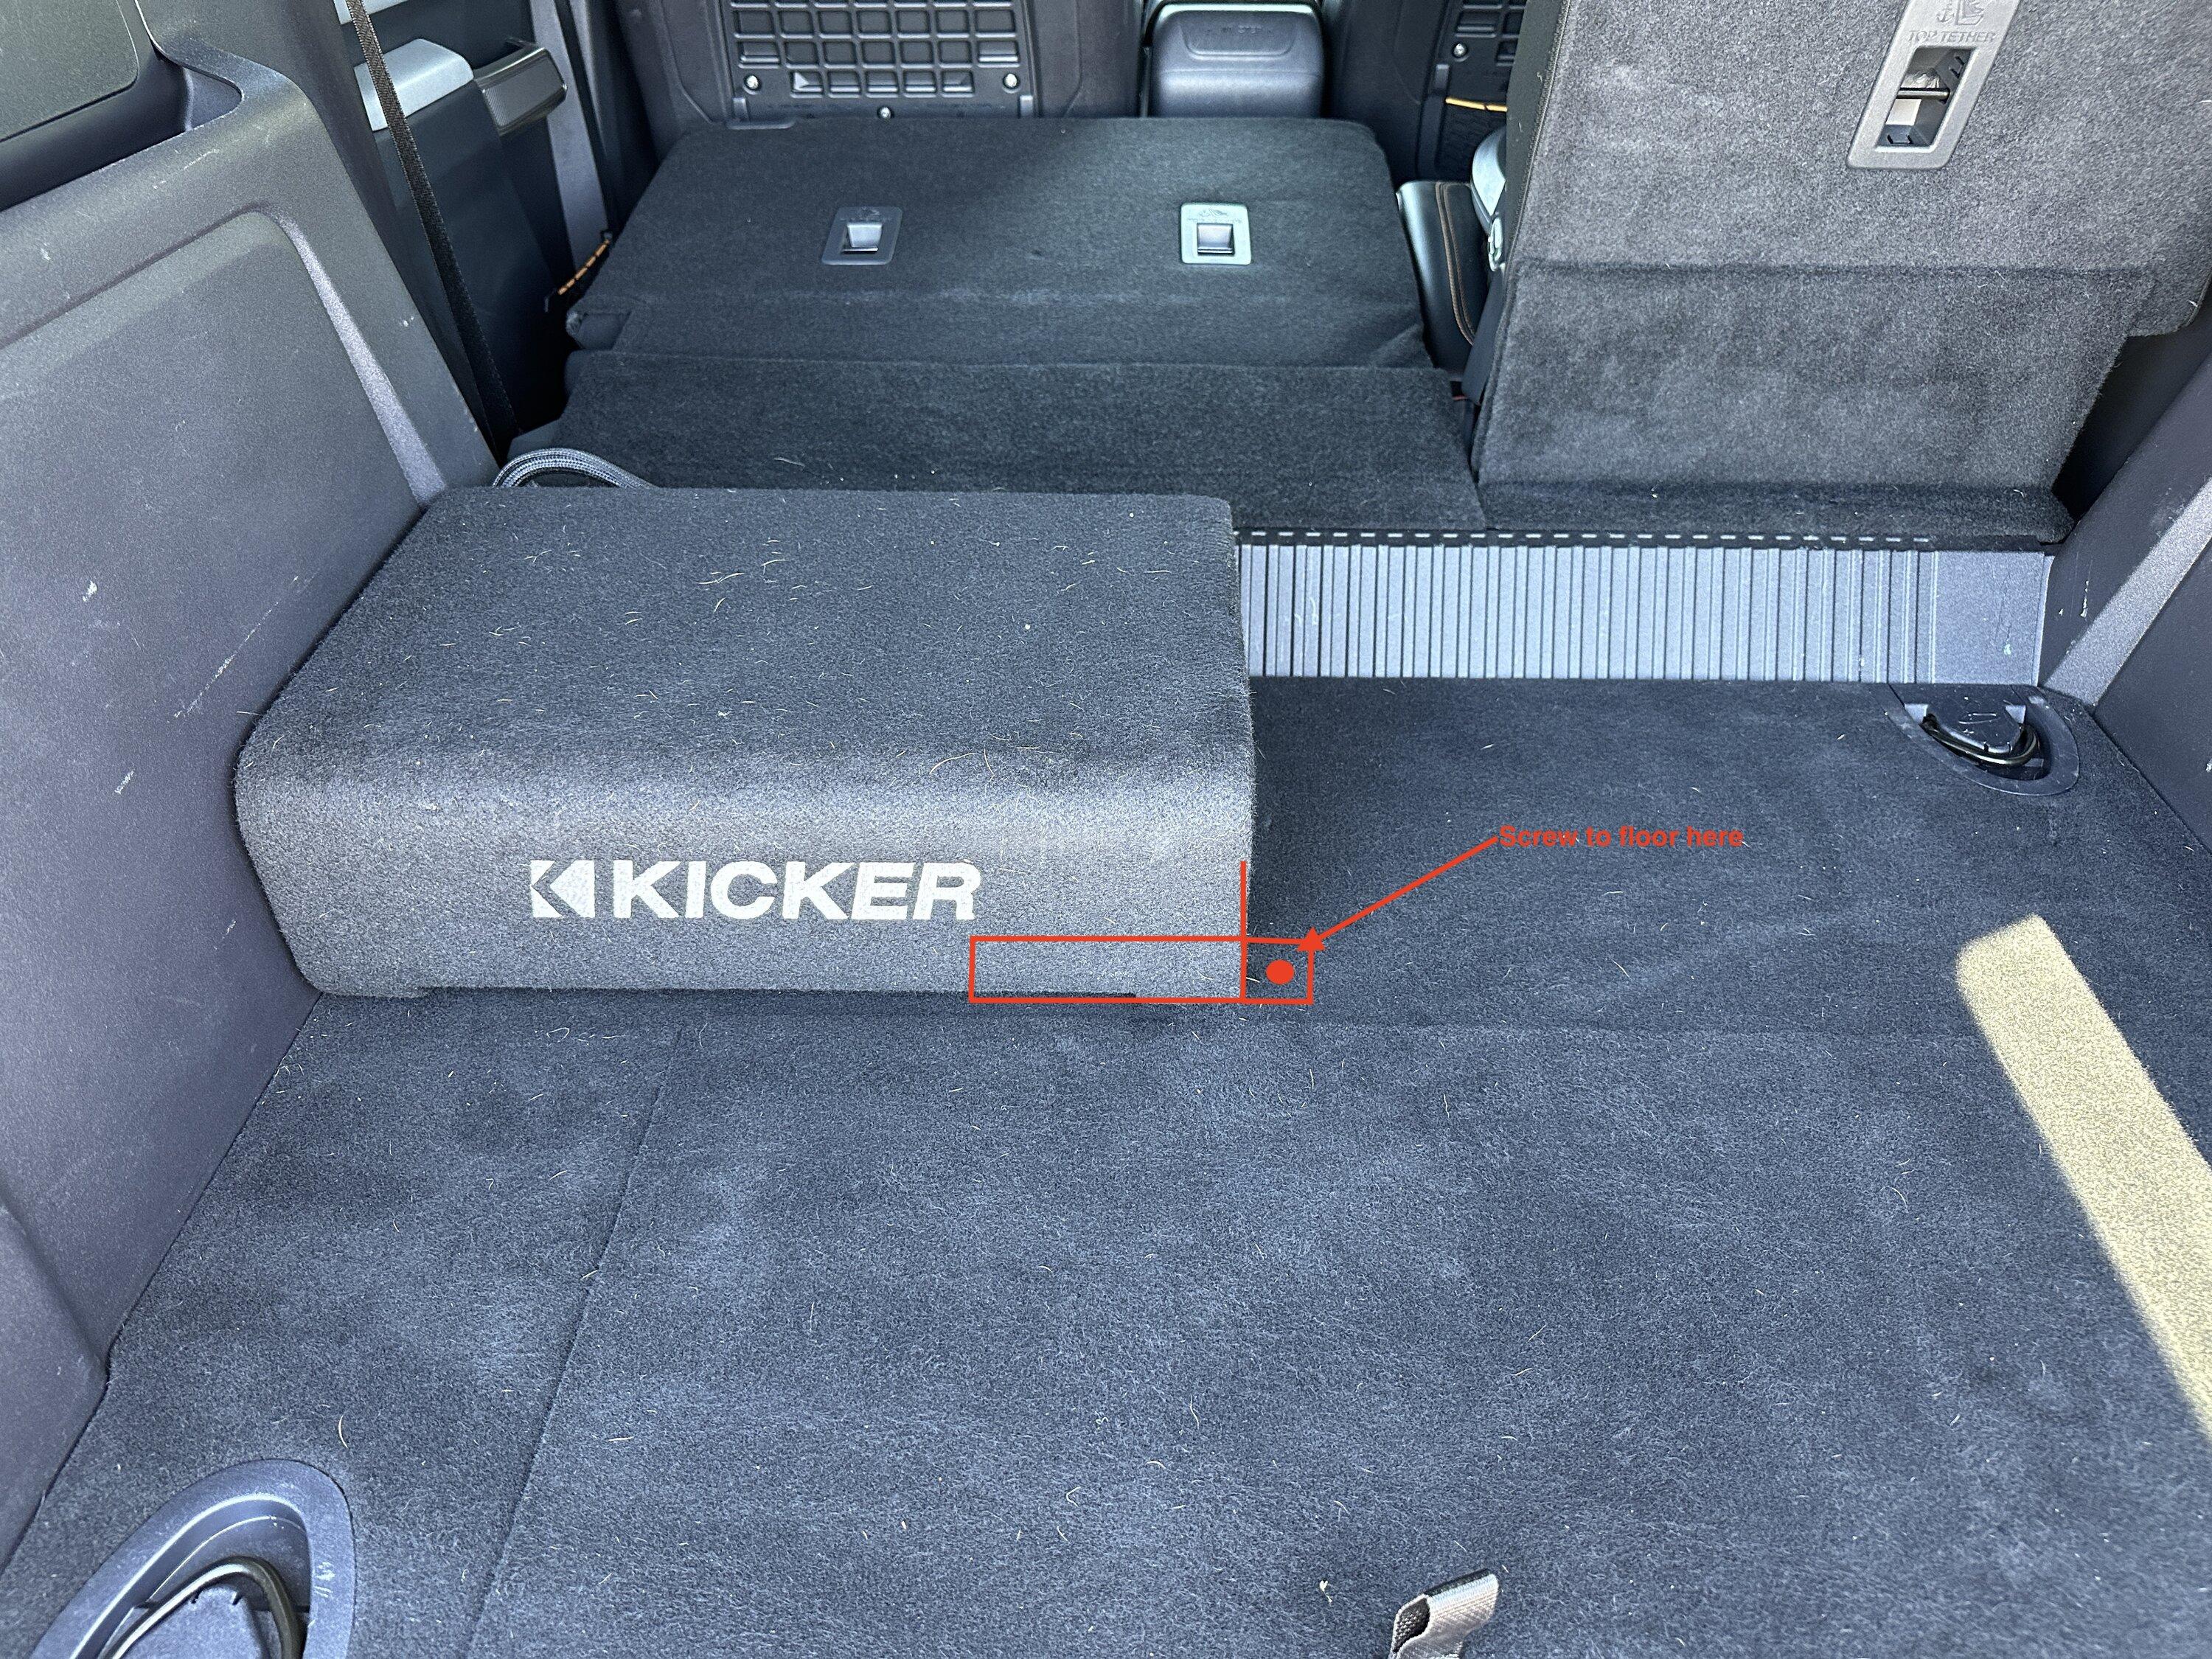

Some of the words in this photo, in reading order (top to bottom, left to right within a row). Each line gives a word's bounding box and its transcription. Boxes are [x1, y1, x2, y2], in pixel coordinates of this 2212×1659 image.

[1907, 29, 1938, 42] TOP
[1939, 30, 1997, 43] TETHER
[612, 860, 982, 921] KICKER
